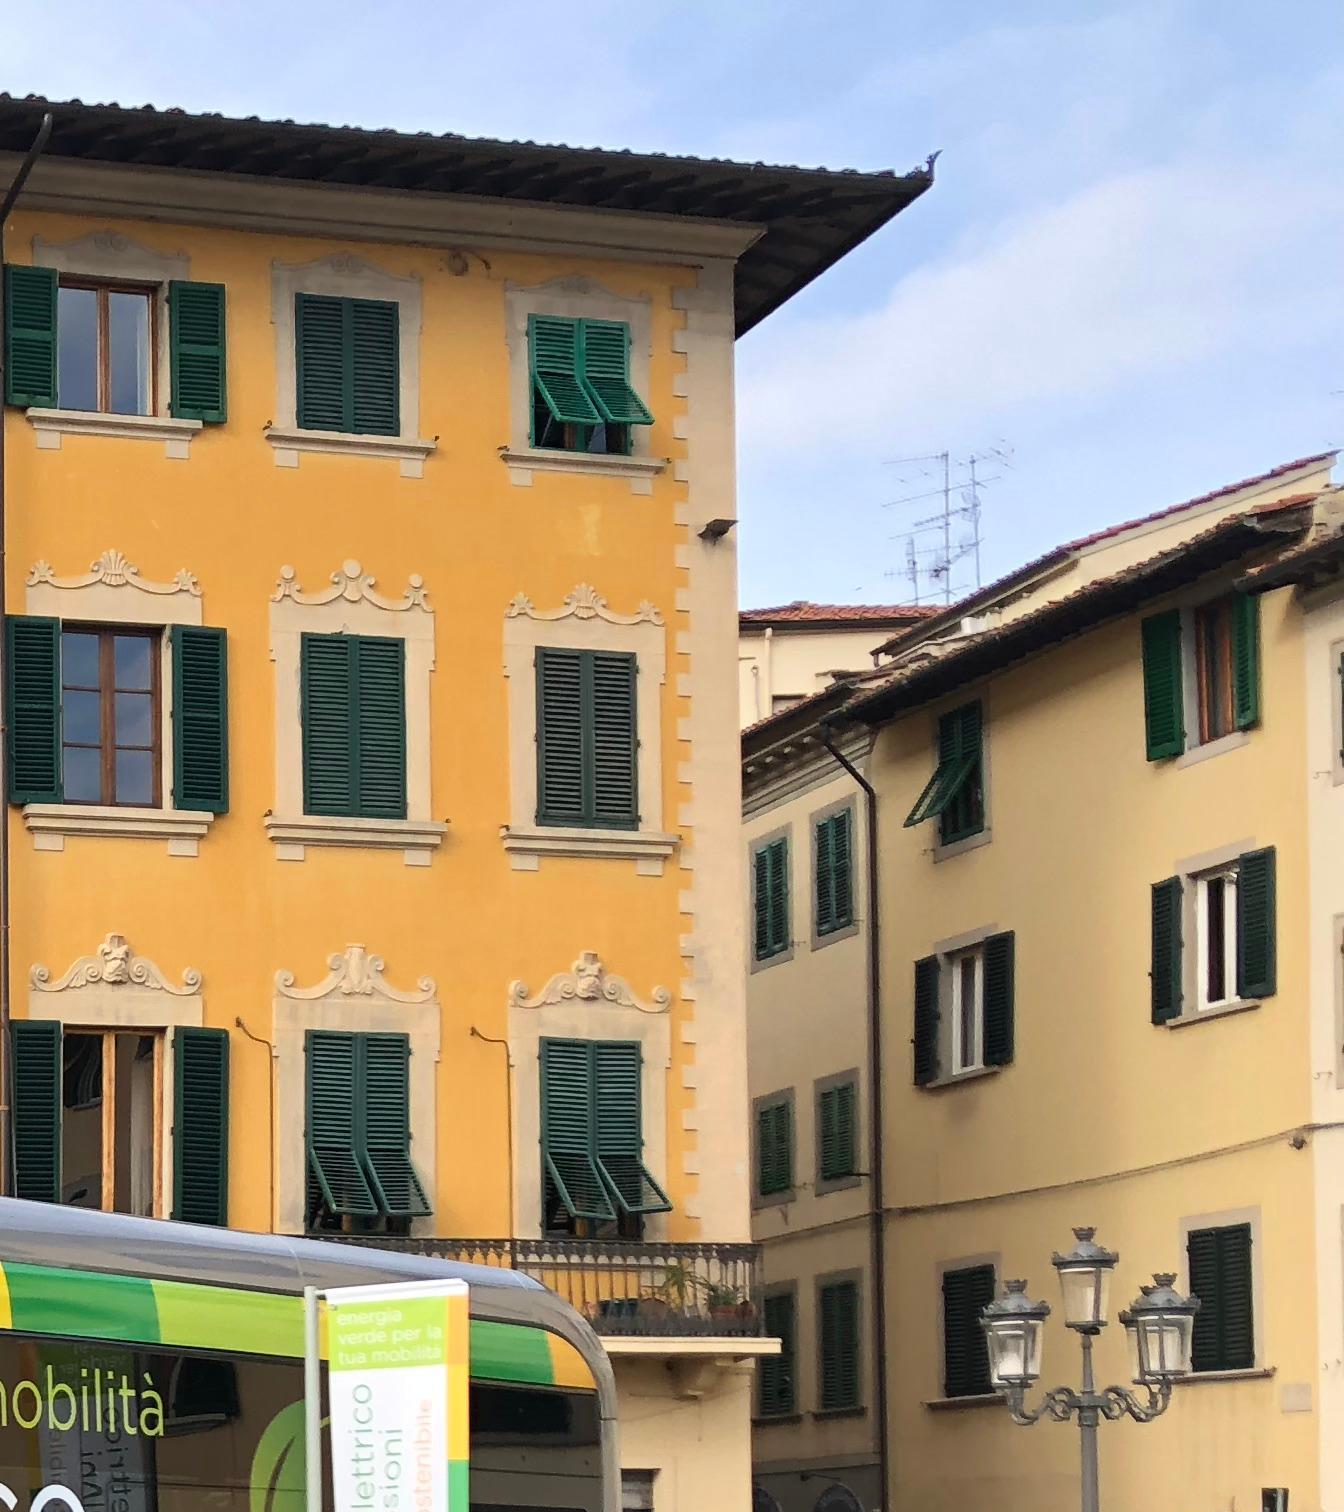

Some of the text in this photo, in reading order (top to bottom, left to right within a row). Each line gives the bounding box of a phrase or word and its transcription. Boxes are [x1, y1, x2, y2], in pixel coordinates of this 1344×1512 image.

[336, 1309, 403, 1325] energia
[338, 1324, 443, 1345] verde per la
[339, 1349, 367, 1365] tua
